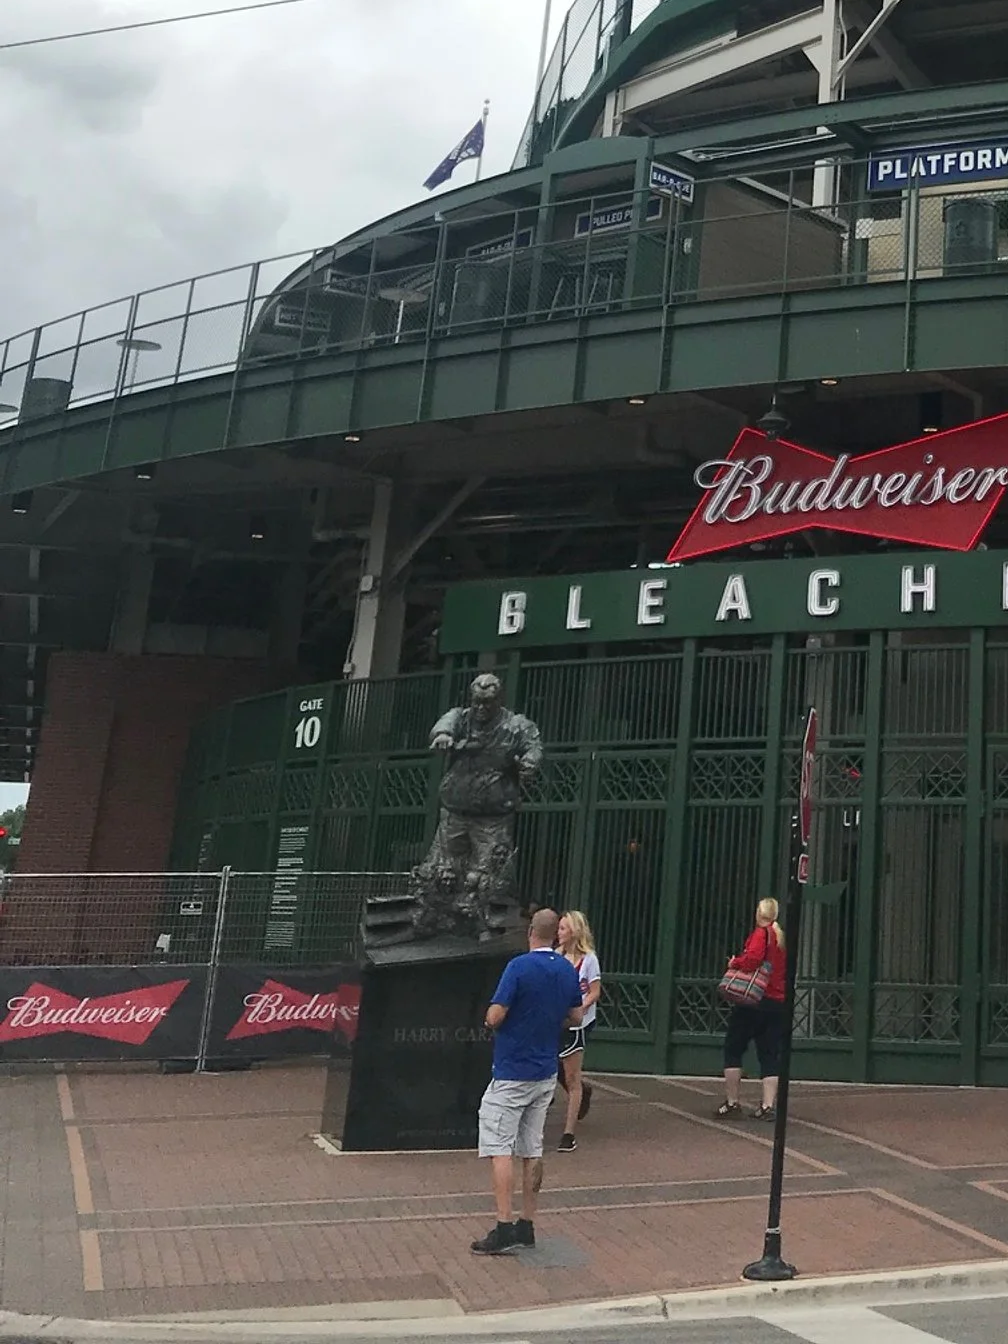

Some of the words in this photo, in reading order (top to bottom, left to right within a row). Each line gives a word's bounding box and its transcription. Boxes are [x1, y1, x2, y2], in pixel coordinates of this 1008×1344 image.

[300, 698, 324, 712] GATE
[295, 716, 321, 748] 10
[7, 995, 169, 1028] Budweiser
